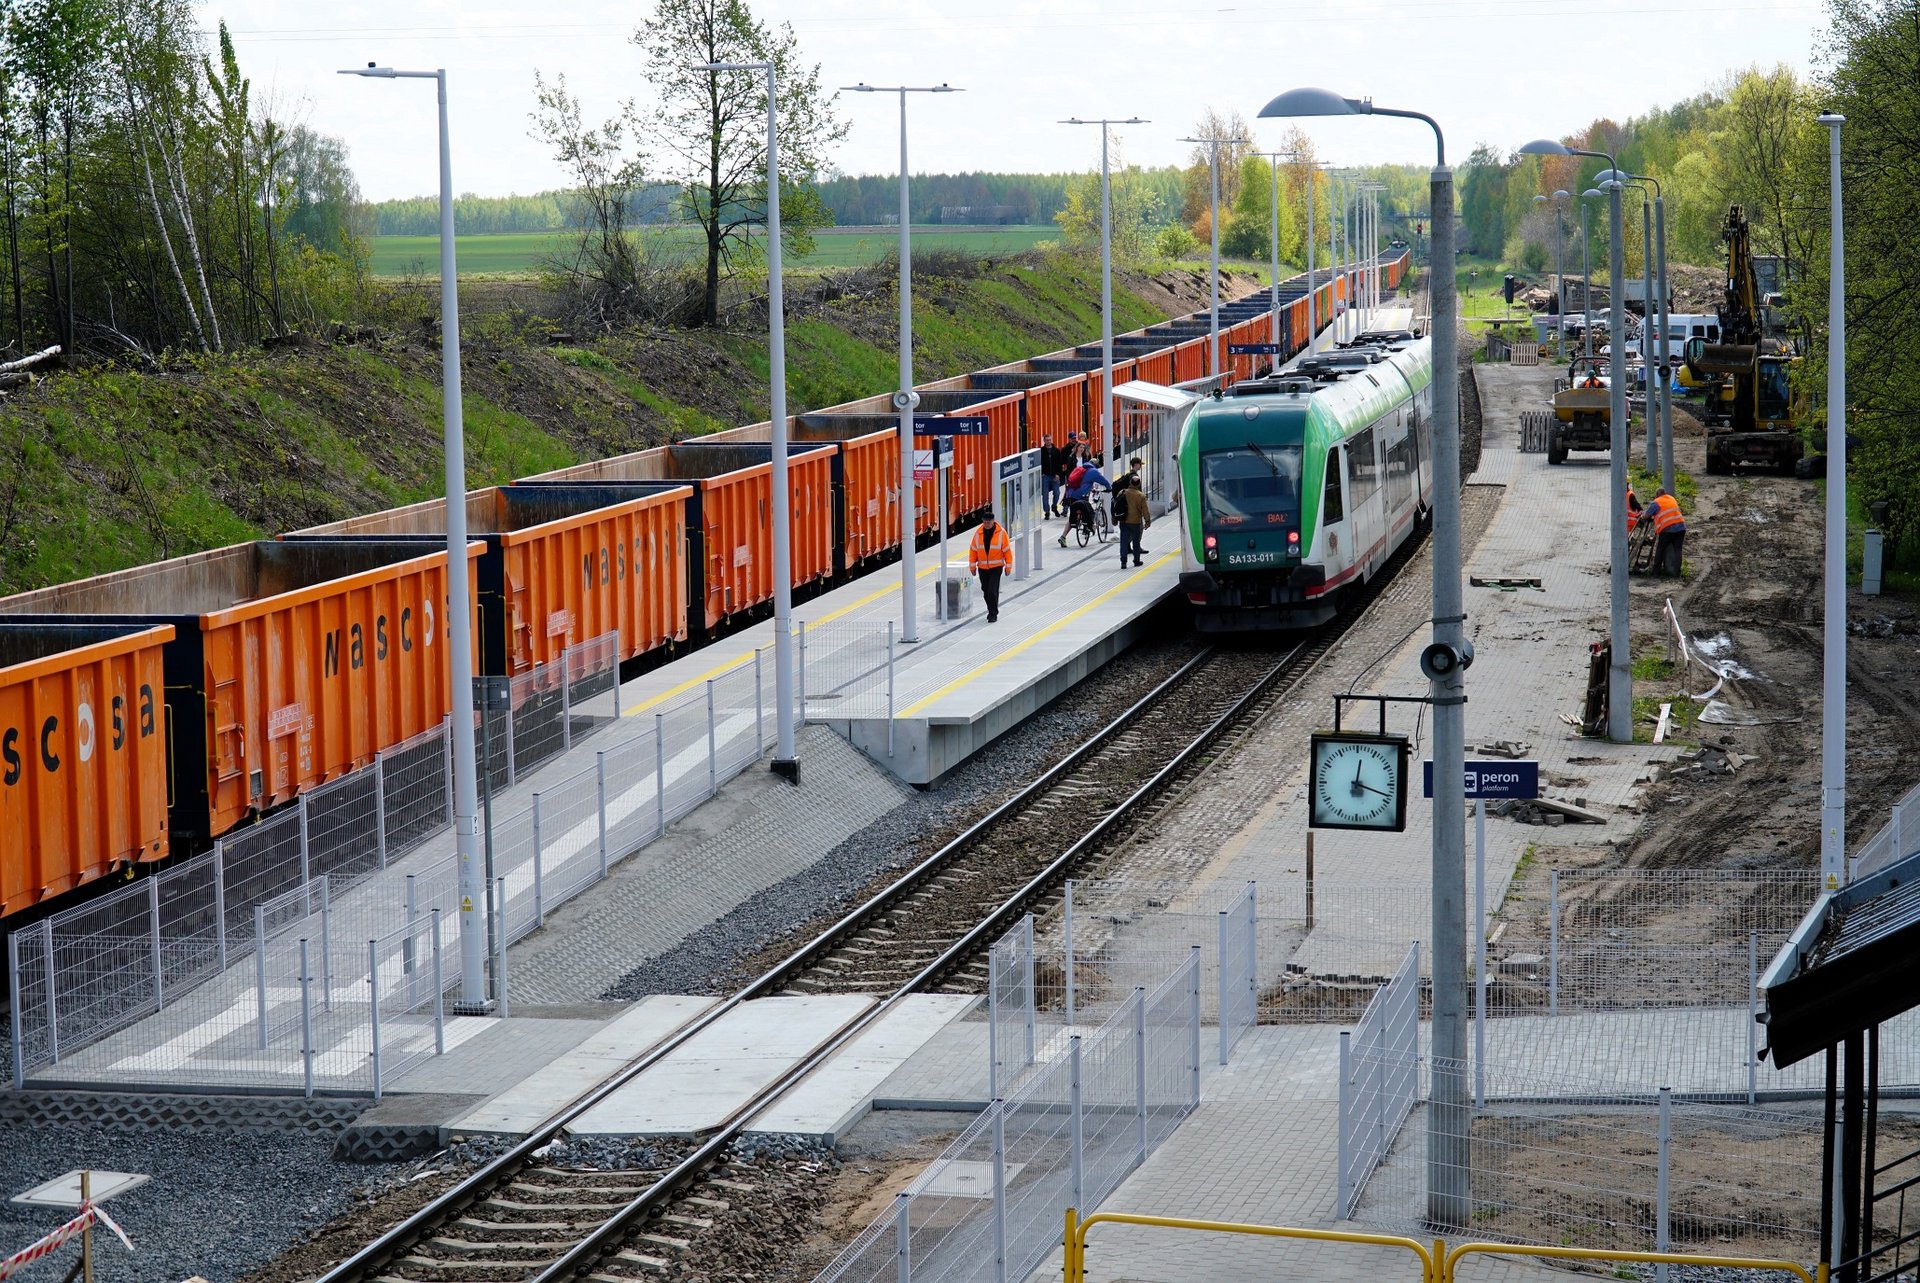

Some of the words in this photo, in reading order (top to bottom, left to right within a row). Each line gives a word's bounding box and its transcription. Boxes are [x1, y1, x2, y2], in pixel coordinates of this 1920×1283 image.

[977, 421, 982, 433] 1
[1229, 553, 1274, 564] SA133-011
[1481, 773, 1519, 785] peron
[1481, 784, 1509, 792] platform
